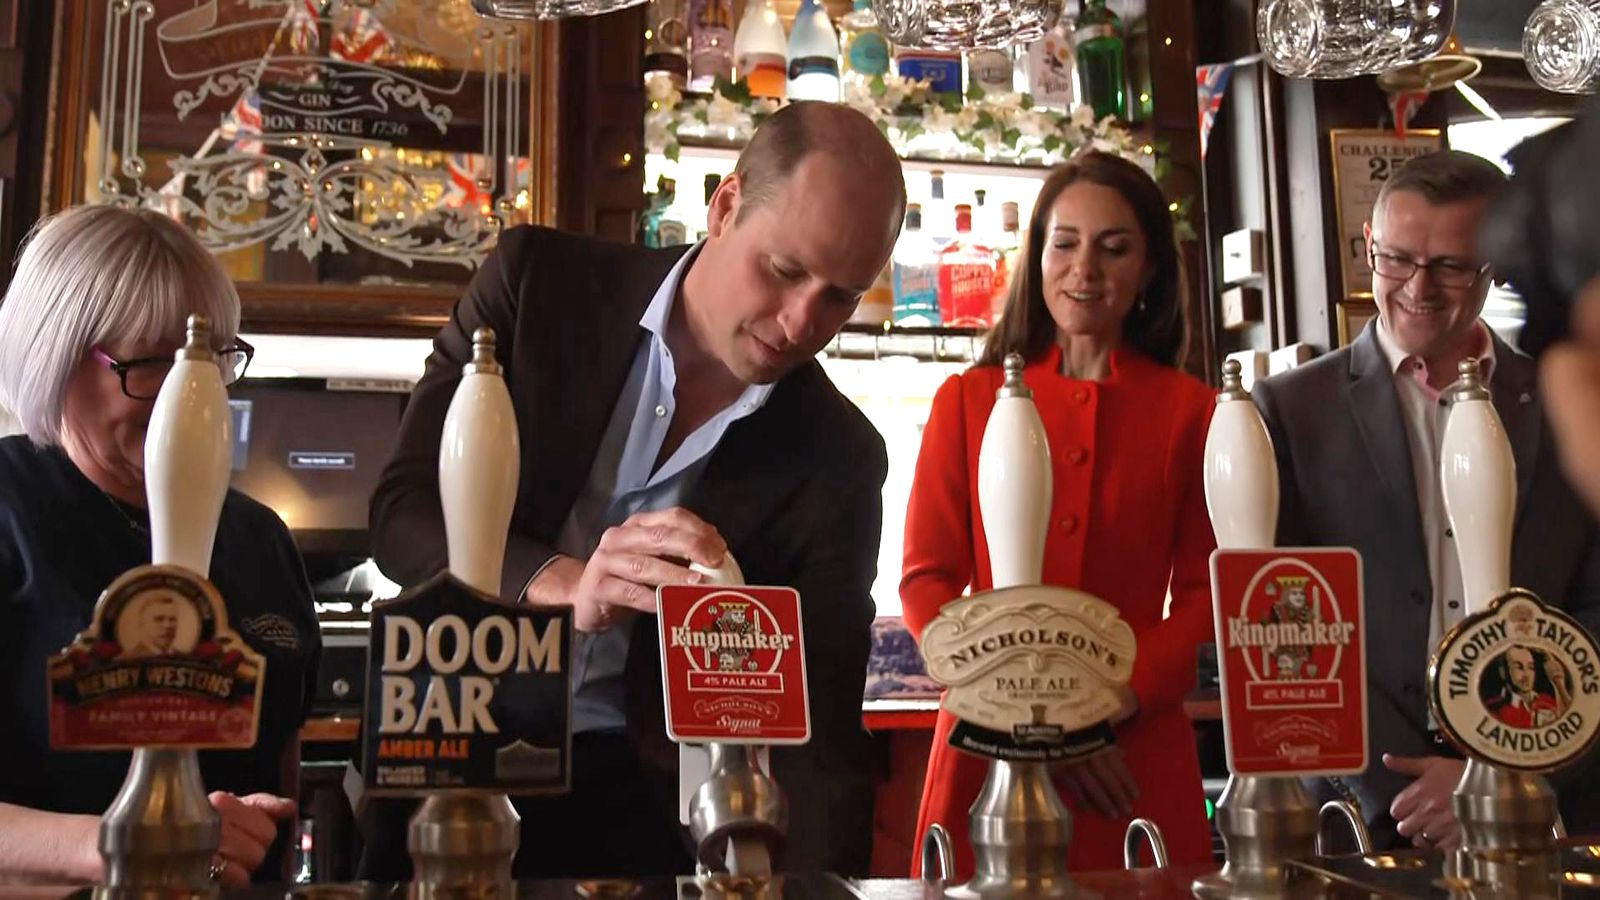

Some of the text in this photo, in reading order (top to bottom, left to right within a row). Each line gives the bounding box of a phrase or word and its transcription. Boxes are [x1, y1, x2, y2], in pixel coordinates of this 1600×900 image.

[298, 93, 332, 107] GIN
[303, 115, 364, 134] SINCE
[371, 119, 408, 136] 1736
[381, 613, 563, 675] DOOM
[670, 625, 795, 653] Kingmaker
[950, 628, 1119, 670] NICHOLSON'S
[1227, 616, 1355, 654] Kingmaker
[1448, 618, 1600, 700] TIMOTHY TAYLOR'S
[77, 666, 235, 698] HENRY WESTONS
[704, 676, 768, 688] 4% PALE ALE
[995, 676, 1082, 691] PALE ALE
[1280, 688, 1306, 699] PALE
[1307, 687, 1327, 699] ALE
[88, 709, 217, 723] FAMILY VINTAGE
[378, 674, 500, 734] BAR
[1475, 710, 1584, 753] LANDLORD
[378, 738, 470, 759] AMBER ALE
